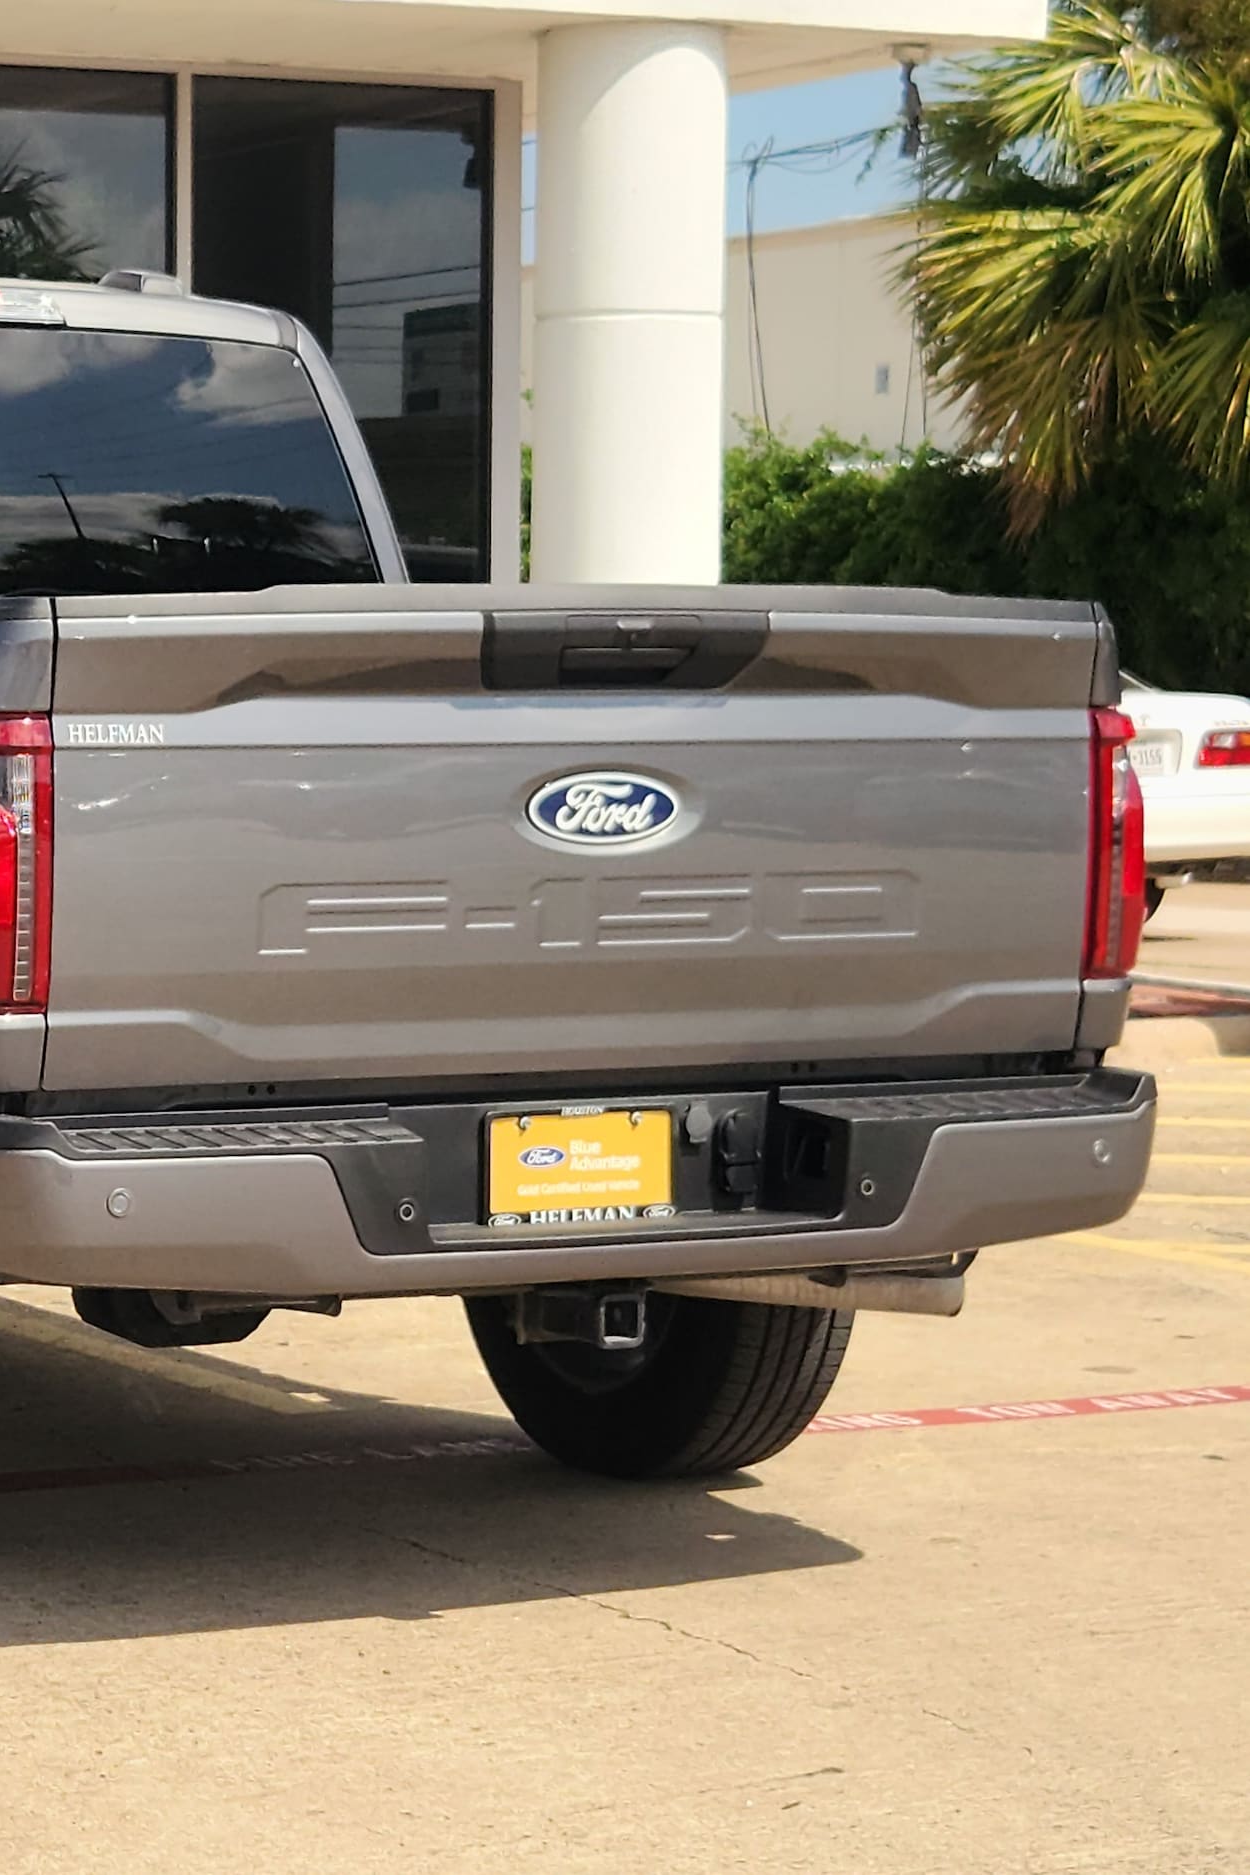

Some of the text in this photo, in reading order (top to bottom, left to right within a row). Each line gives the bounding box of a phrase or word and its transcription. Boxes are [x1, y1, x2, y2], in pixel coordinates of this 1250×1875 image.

[67, 723, 165, 744] HELFMAN
[555, 783, 658, 834] Ford
[569, 1139, 601, 1155] Blue
[569, 1154, 641, 1172] Advantage
